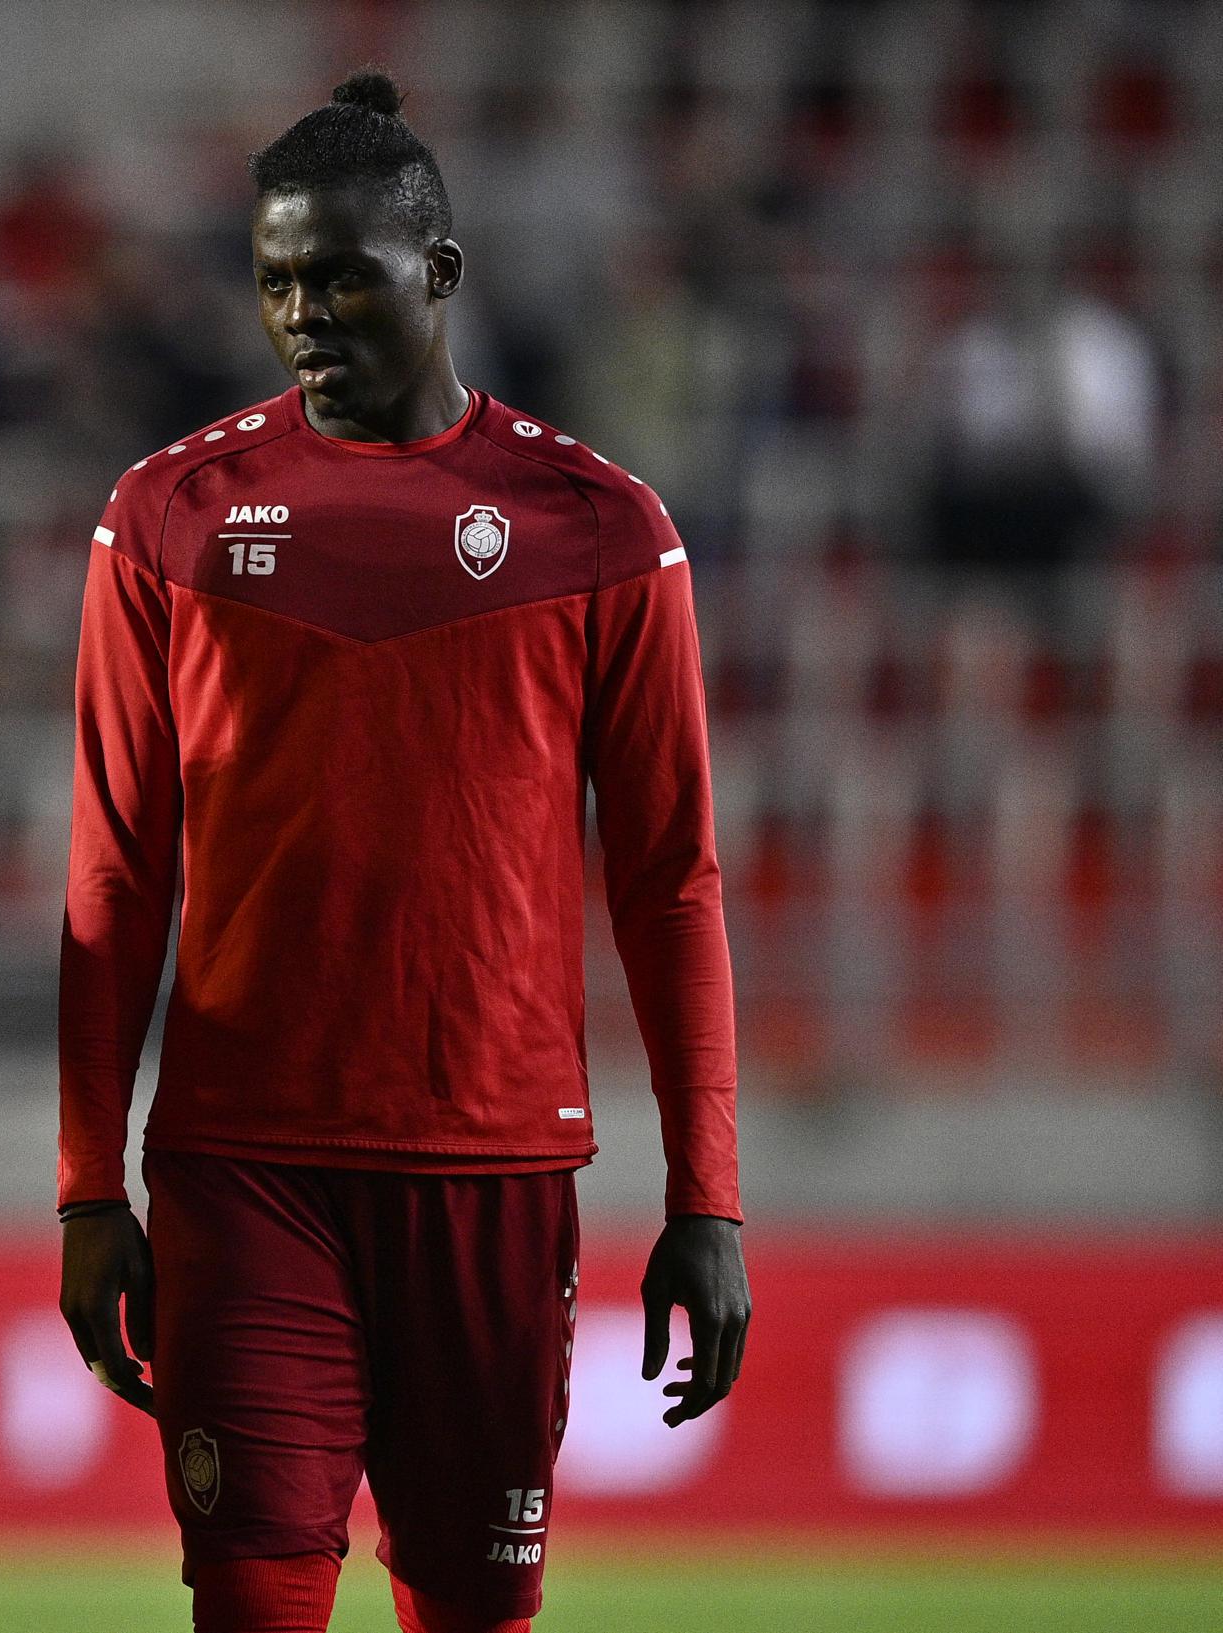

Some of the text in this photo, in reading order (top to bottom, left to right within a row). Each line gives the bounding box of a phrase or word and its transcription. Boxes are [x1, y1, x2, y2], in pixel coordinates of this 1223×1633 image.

[224, 505, 290, 524] JAKO
[228, 543, 276, 575] 15
[505, 1488, 545, 1522] 15
[487, 1542, 542, 1564] JAKO
